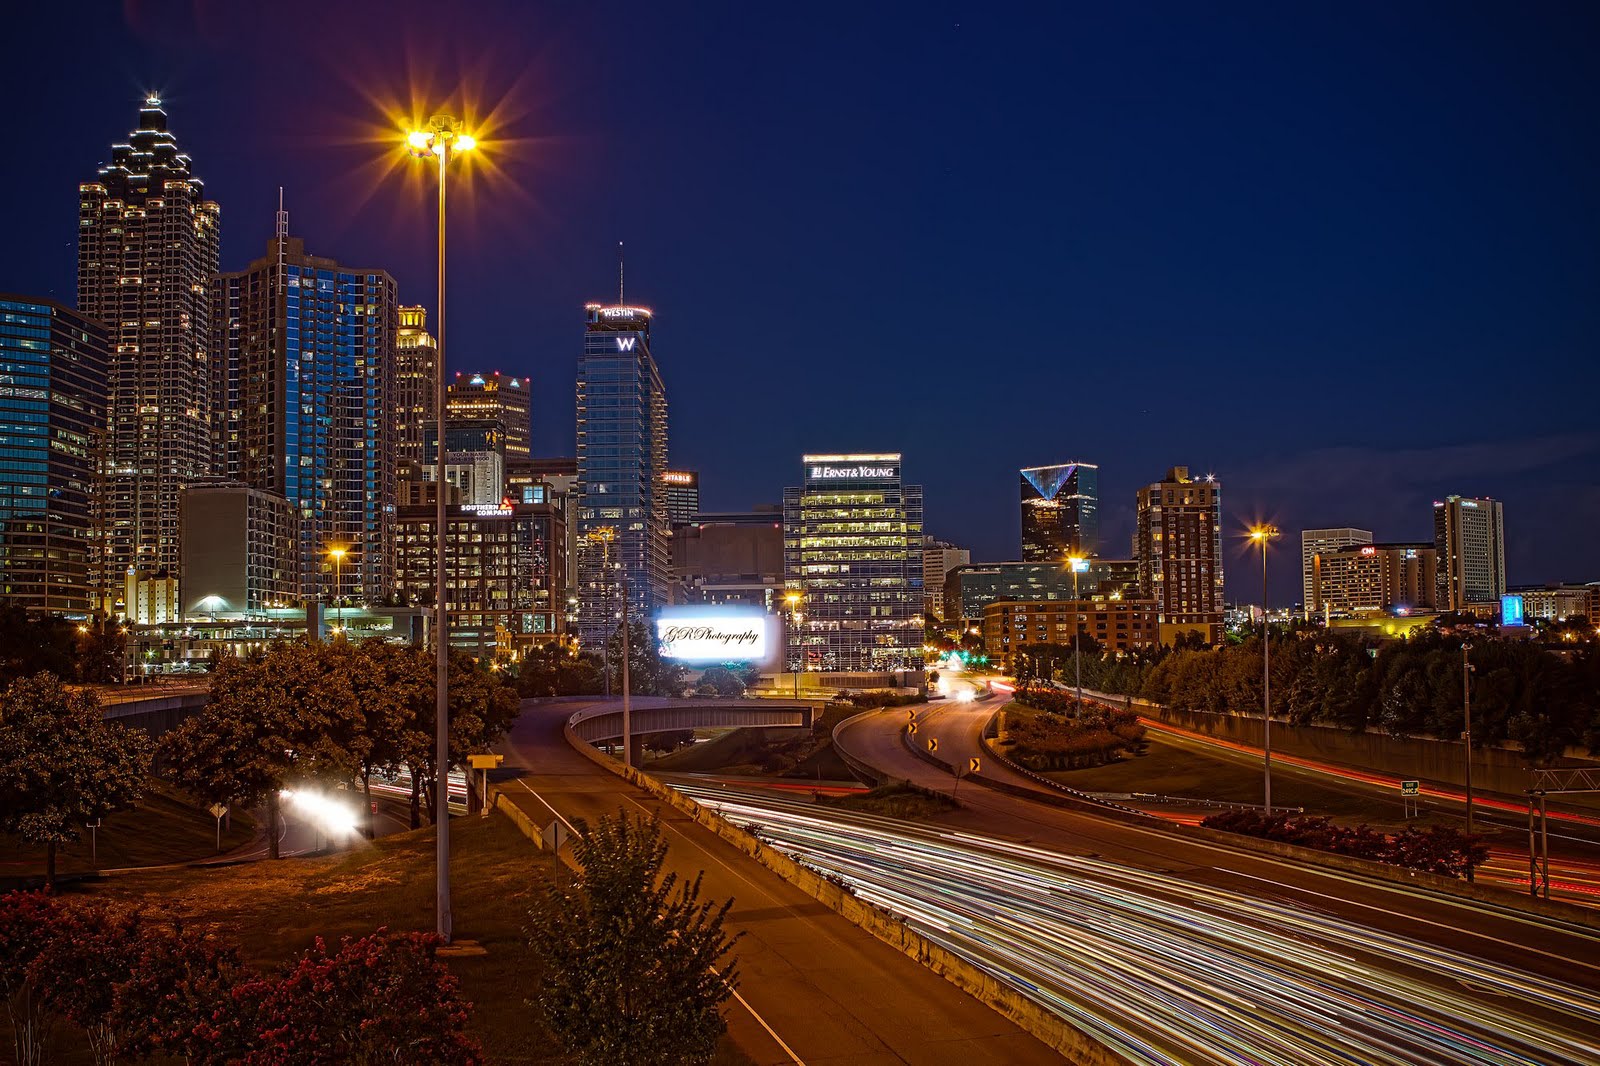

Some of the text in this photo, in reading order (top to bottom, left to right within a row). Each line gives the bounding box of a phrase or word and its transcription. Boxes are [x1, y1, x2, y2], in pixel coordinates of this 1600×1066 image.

[603, 308, 634, 317] WESTIN
[616, 337, 635, 351] W
[1361, 547, 1375, 555] CNN
